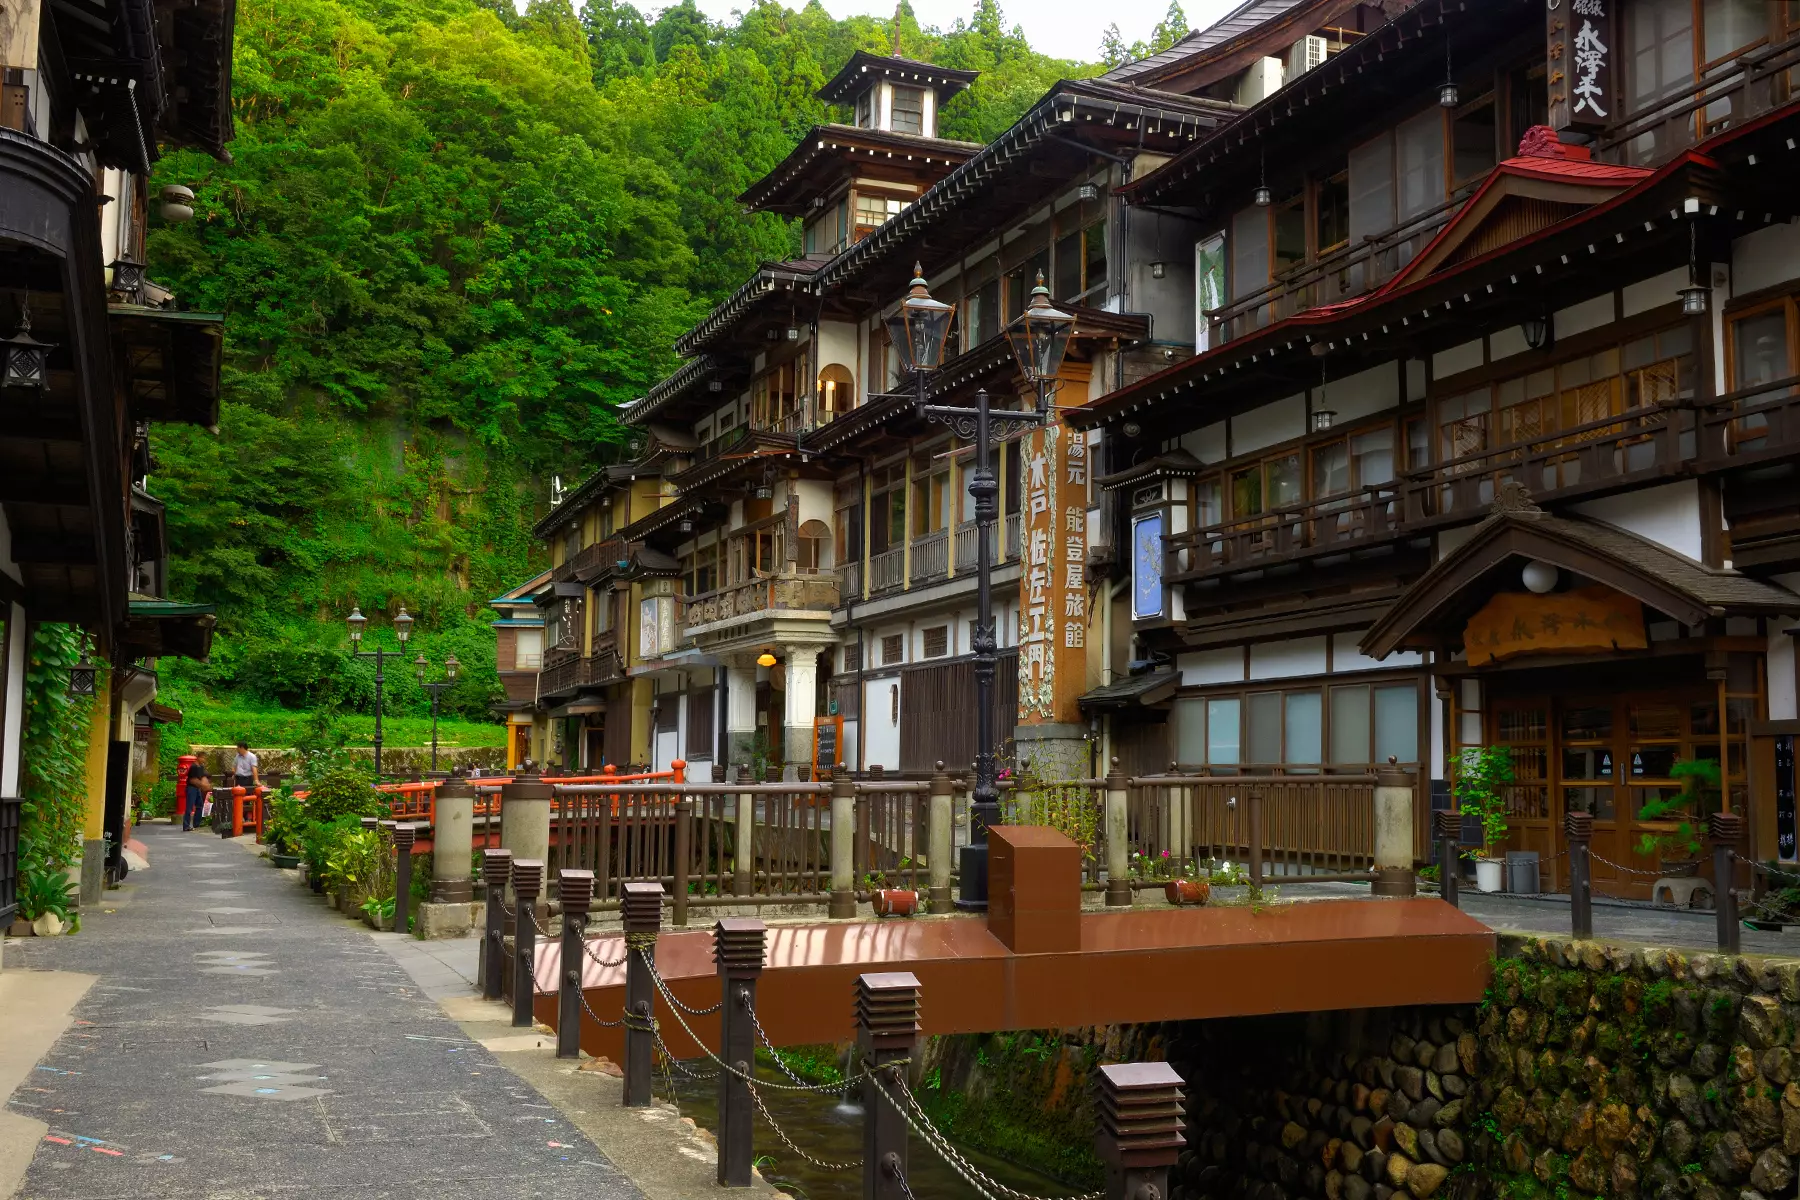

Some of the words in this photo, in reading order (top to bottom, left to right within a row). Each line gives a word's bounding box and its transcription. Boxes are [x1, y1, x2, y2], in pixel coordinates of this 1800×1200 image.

[1573, 19, 1608, 117] 永澤平八
[1067, 431, 1085, 485] 湯元
[1065, 505, 1084, 648] 能登屋旅館
